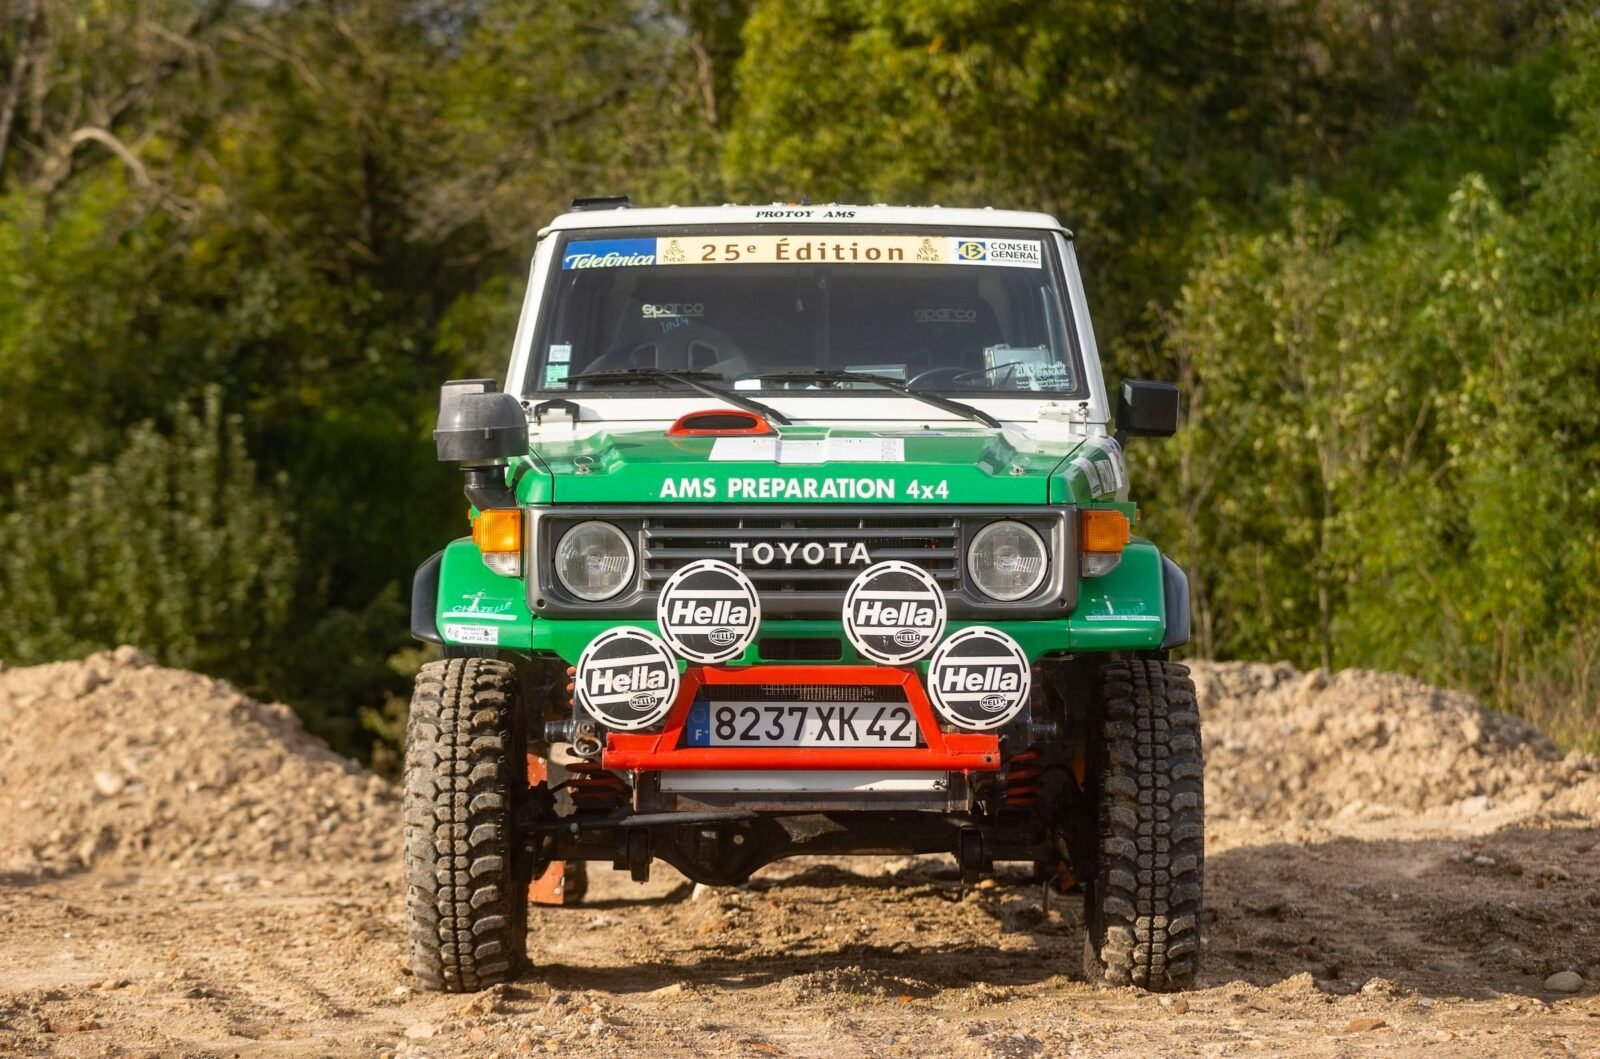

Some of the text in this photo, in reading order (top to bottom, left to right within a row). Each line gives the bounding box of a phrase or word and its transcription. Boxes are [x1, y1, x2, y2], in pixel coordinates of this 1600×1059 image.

[755, 210, 856, 218] PROTOY AMS
[776, 237, 904, 261] Édition
[965, 244, 982, 257] 13
[990, 242, 1039, 252] CONSEIL
[991, 250, 1039, 260] GENERAL
[641, 303, 704, 318] sparco
[659, 477, 949, 499] AMS PREPARATION 4x4
[730, 542, 872, 565] TOYOTA
[670, 600, 748, 625] Hella
[856, 600, 934, 626] Hella
[711, 632, 735, 640] HELLA
[590, 665, 666, 696] Hella
[942, 666, 1019, 692] Hella
[695, 729, 702, 740] F
[715, 706, 911, 741] 8237 XK 42
